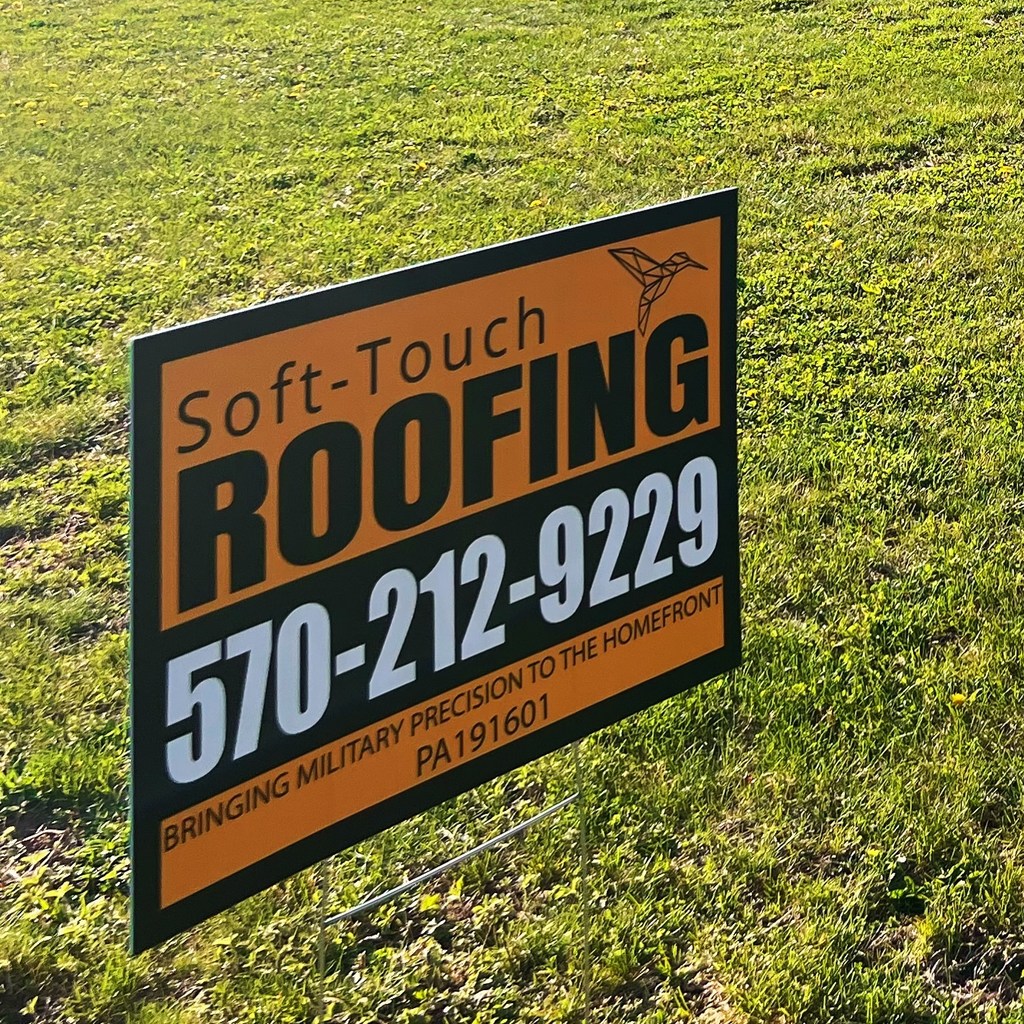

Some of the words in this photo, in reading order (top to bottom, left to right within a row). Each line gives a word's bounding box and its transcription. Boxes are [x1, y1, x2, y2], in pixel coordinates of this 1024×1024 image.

[177, 297, 545, 454] Soft-Touch
[177, 313, 709, 613] ROOFING
[163, 772, 290, 853] BRINGING
[296, 718, 404, 787] MILITARY
[411, 674, 522, 737] PRECISION
[527, 658, 556, 690] TO
[559, 635, 598, 676] THE
[602, 584, 722, 653] HOMEFRONT
[165, 456, 718, 784] 570-212-9229
[416, 694, 550, 777] PA191601
